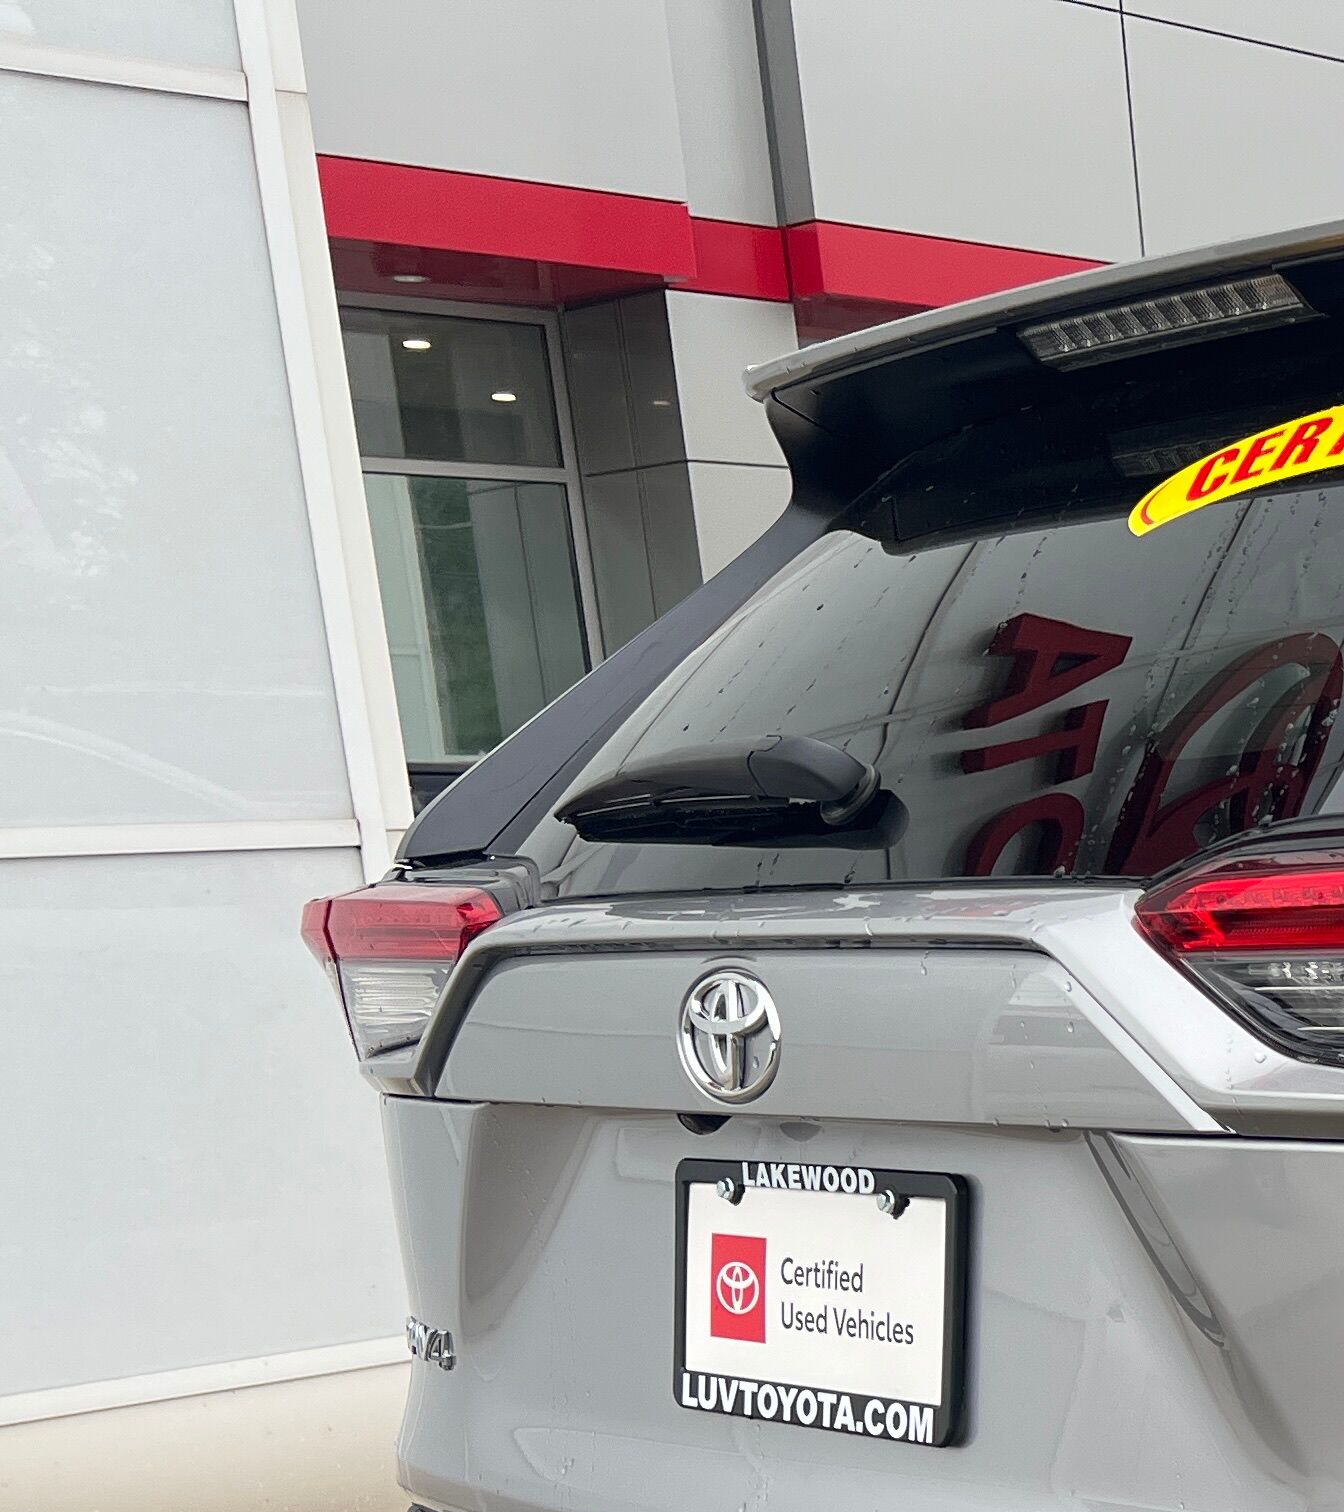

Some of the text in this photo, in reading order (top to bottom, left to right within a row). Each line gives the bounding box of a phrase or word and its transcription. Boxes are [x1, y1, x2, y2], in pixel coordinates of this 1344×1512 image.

[741, 1161, 876, 1195] LAKEWOOD
[780, 1256, 864, 1294] Certified
[780, 1301, 915, 1346] Used Vehicles
[680, 1372, 934, 1444] LUVTOYOTA.COM
